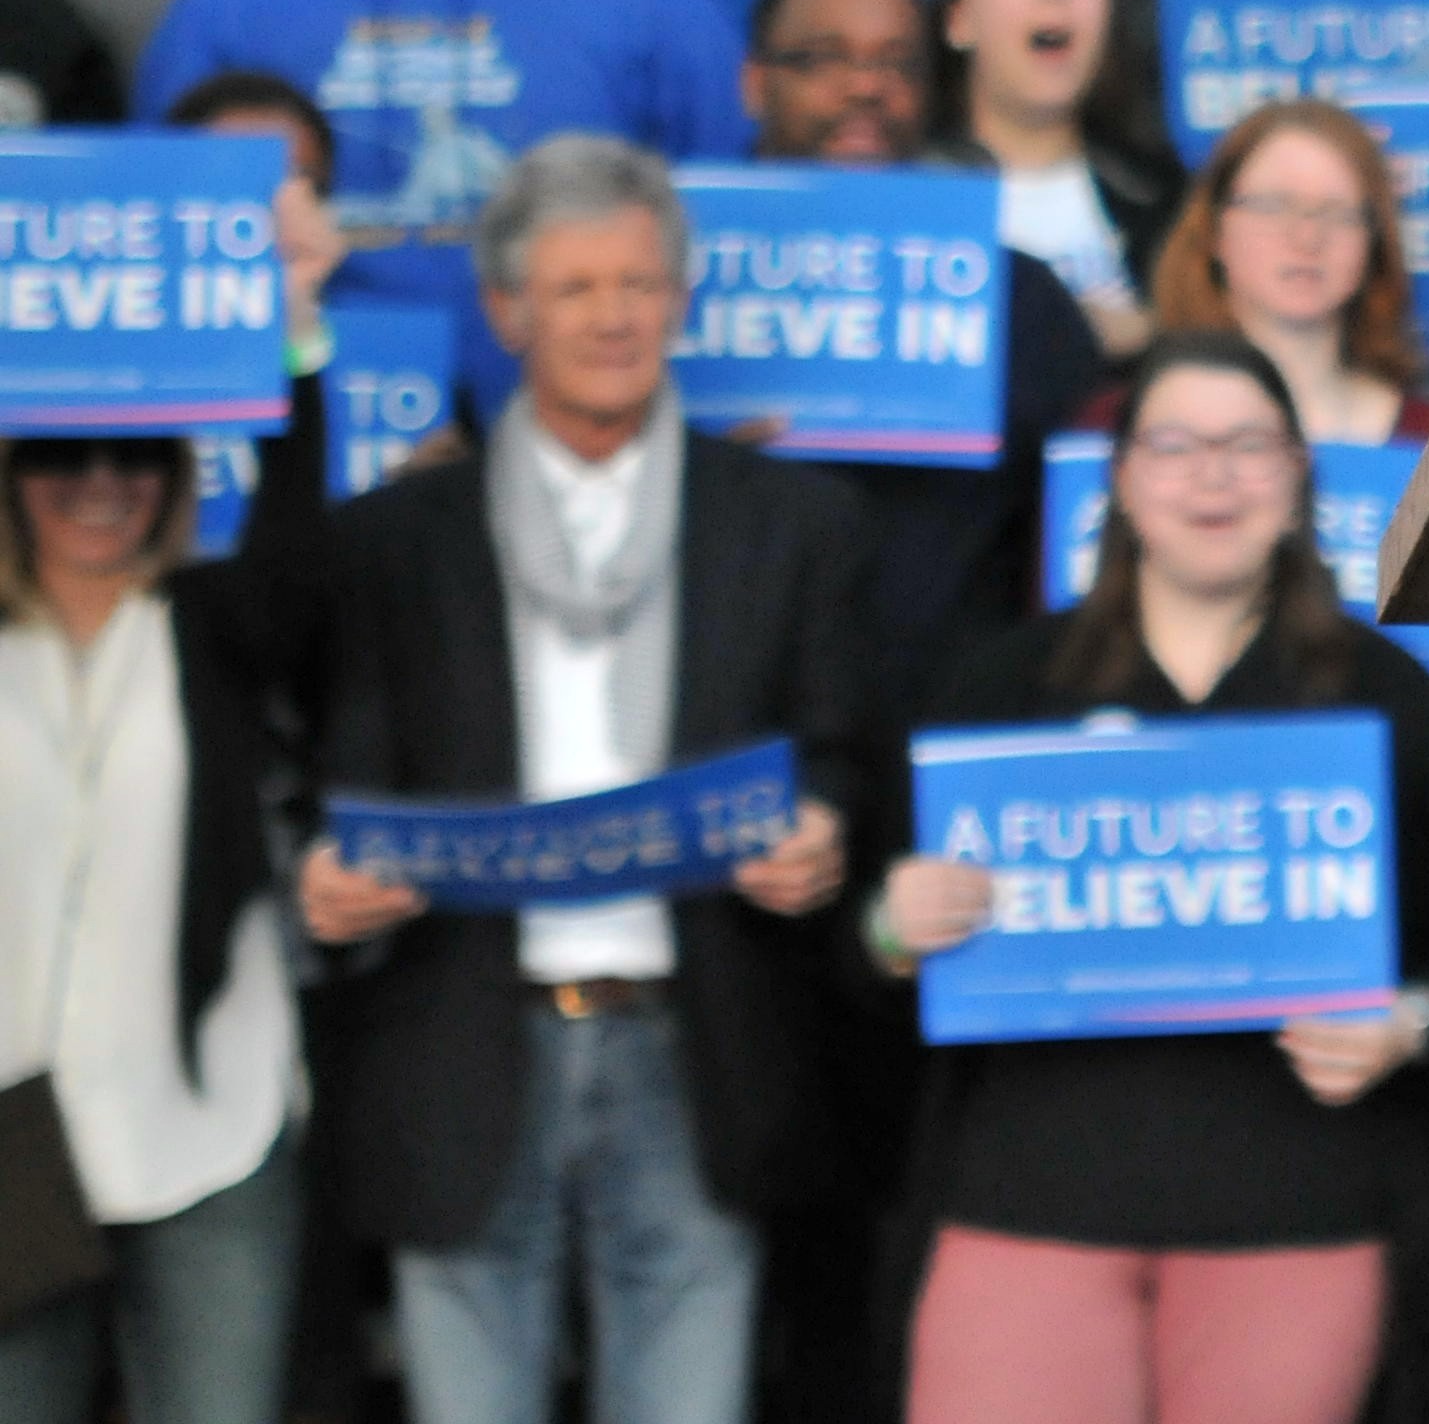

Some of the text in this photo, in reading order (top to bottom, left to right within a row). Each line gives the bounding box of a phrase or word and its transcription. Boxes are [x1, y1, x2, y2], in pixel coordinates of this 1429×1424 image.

[1186, 10, 1227, 62] A
[0, 199, 273, 261] TURE TO
[179, 263, 274, 331] IN
[693, 233, 991, 298] TURE TO
[700, 295, 989, 368] IEVE IN
[339, 372, 442, 432] TO
[944, 785, 1375, 862] A FUTURE TO
[992, 855, 1376, 935] ELIEVE IN
